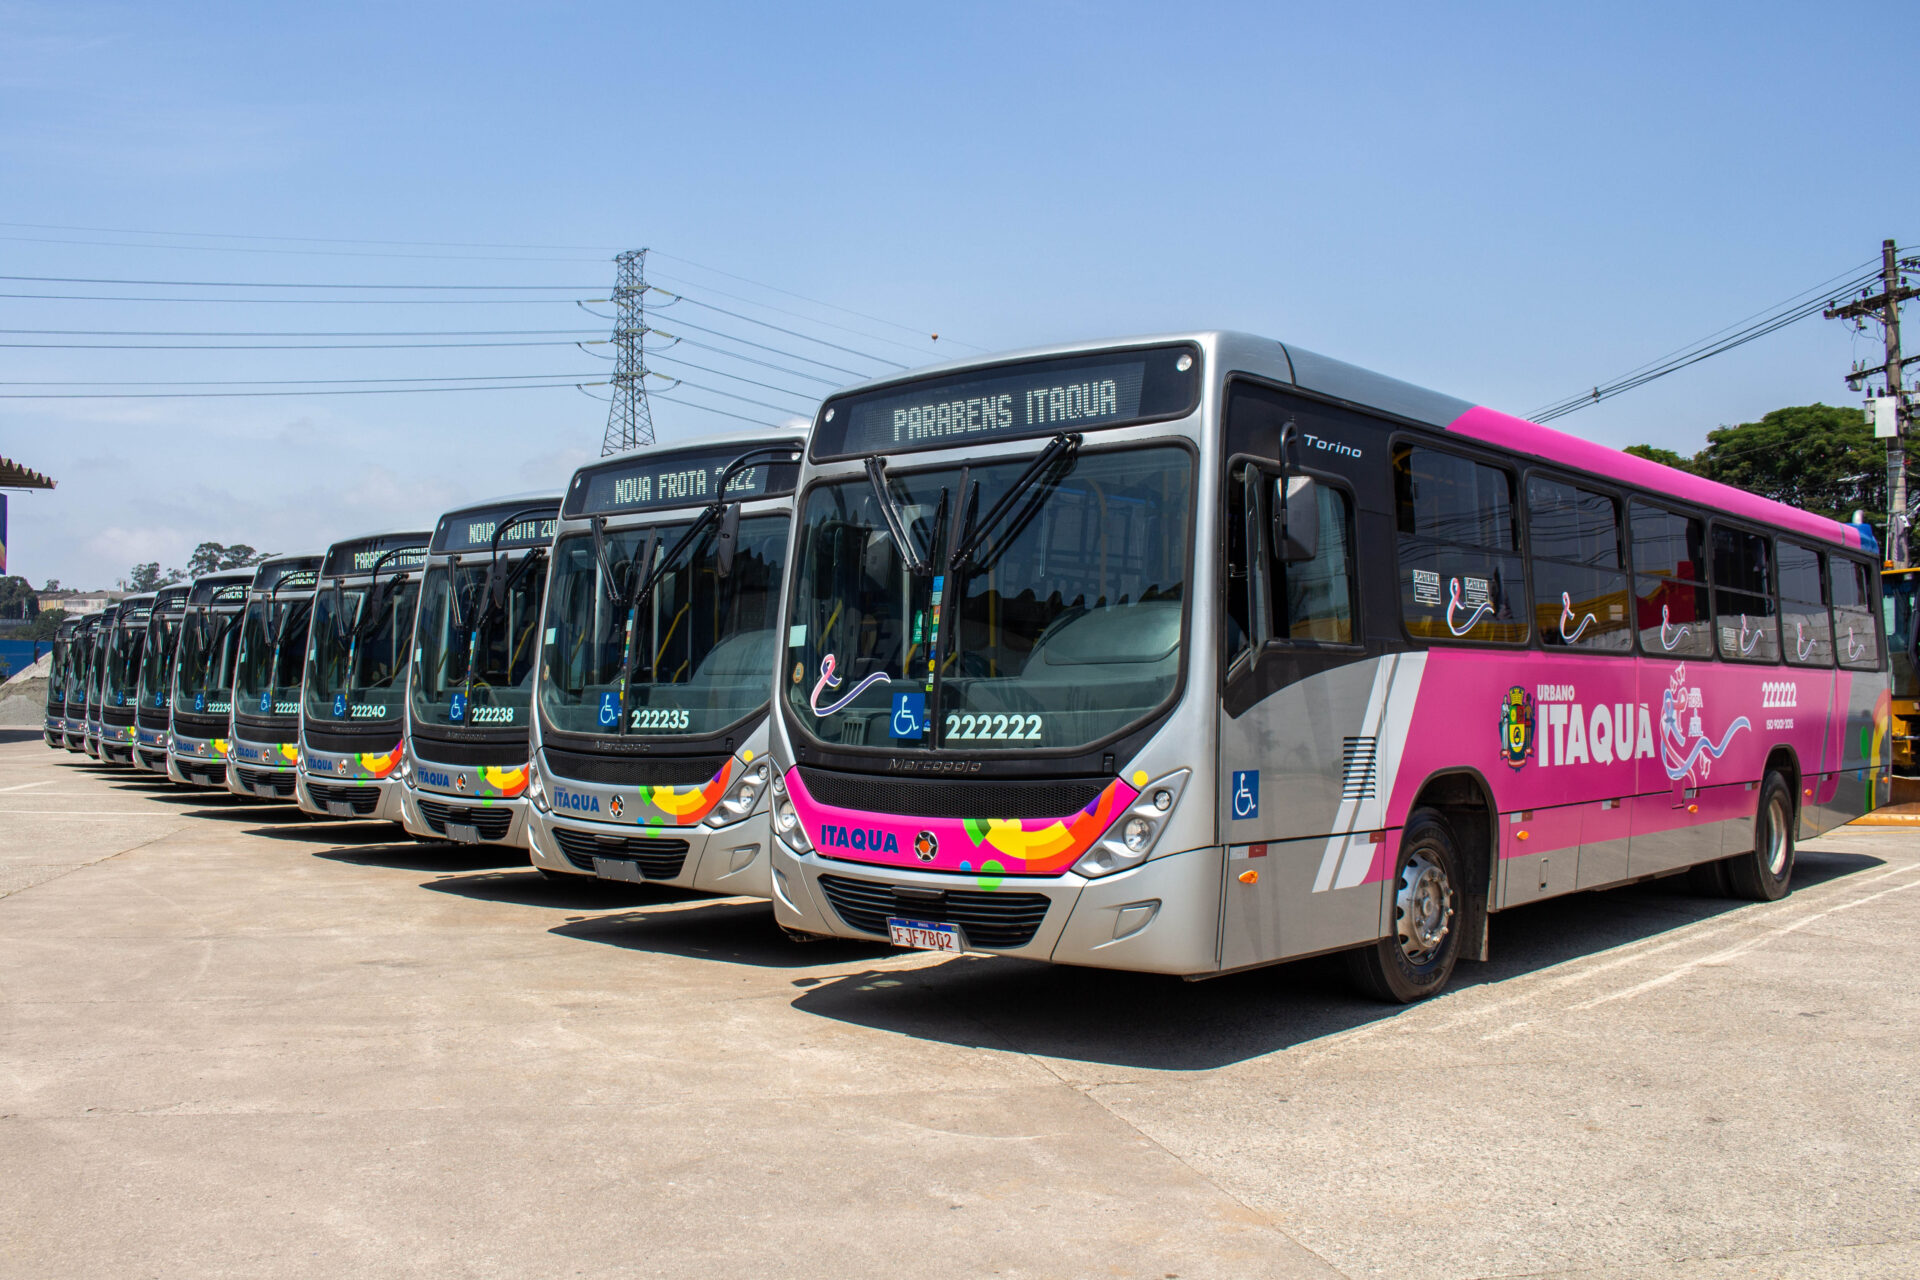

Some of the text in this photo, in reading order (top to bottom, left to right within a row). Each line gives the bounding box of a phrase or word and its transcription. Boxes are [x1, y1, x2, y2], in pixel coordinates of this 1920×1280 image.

[894, 379, 1117, 441] PARABENS ITAQUA
[1303, 433, 1362, 458] Torino
[615, 476, 651, 504] NOVA
[658, 469, 706, 499] FROTA
[1537, 684, 1575, 701] URBANO
[1762, 681, 1797, 708] 222222
[350, 705, 386, 717] 222240
[472, 707, 514, 722] 222238
[631, 709, 690, 729] 222235
[945, 714, 1043, 740] 222222
[888, 758, 982, 773] Marcopolo
[821, 824, 899, 853] ITAQUA
